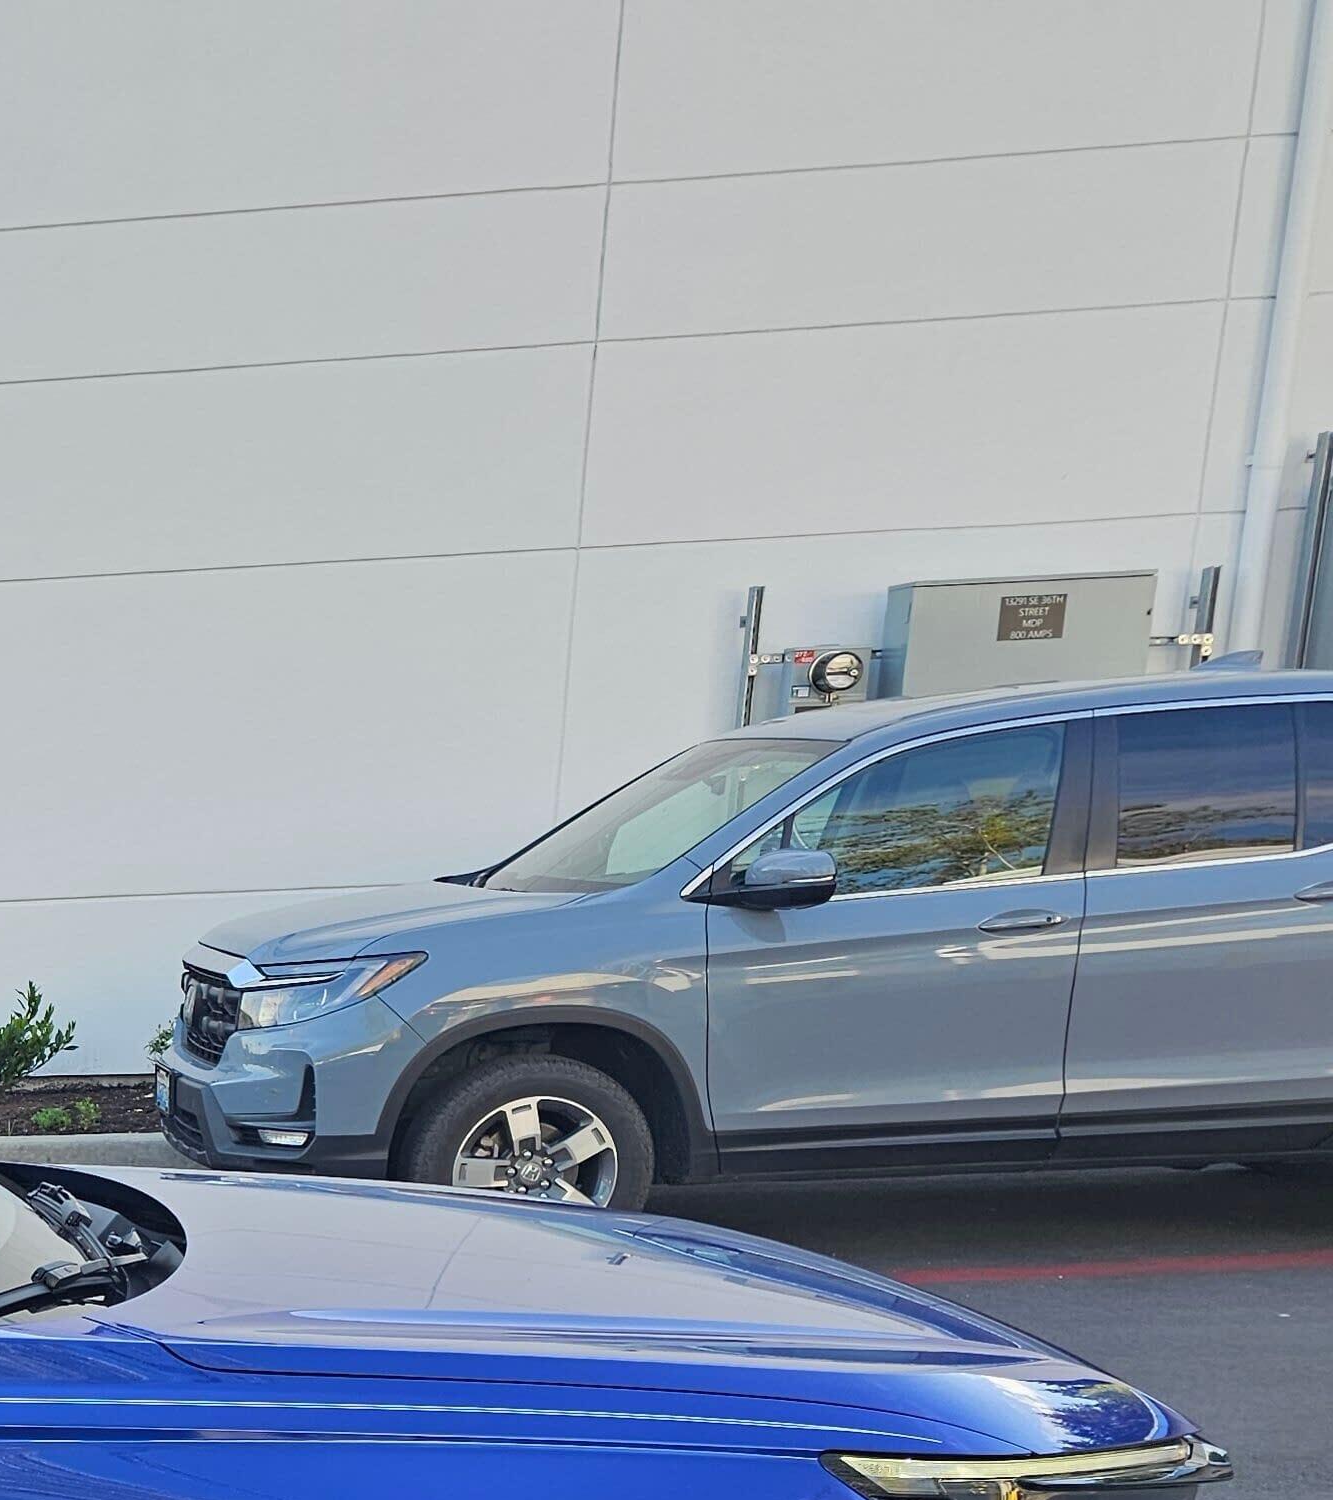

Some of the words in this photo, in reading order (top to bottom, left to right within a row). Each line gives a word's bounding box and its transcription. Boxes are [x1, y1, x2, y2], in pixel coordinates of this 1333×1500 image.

[1028, 596, 1039, 605] SE
[1041, 595, 1064, 605] 36TH
[1018, 607, 1050, 616] STREET
[1027, 629, 1053, 638] AMPS
